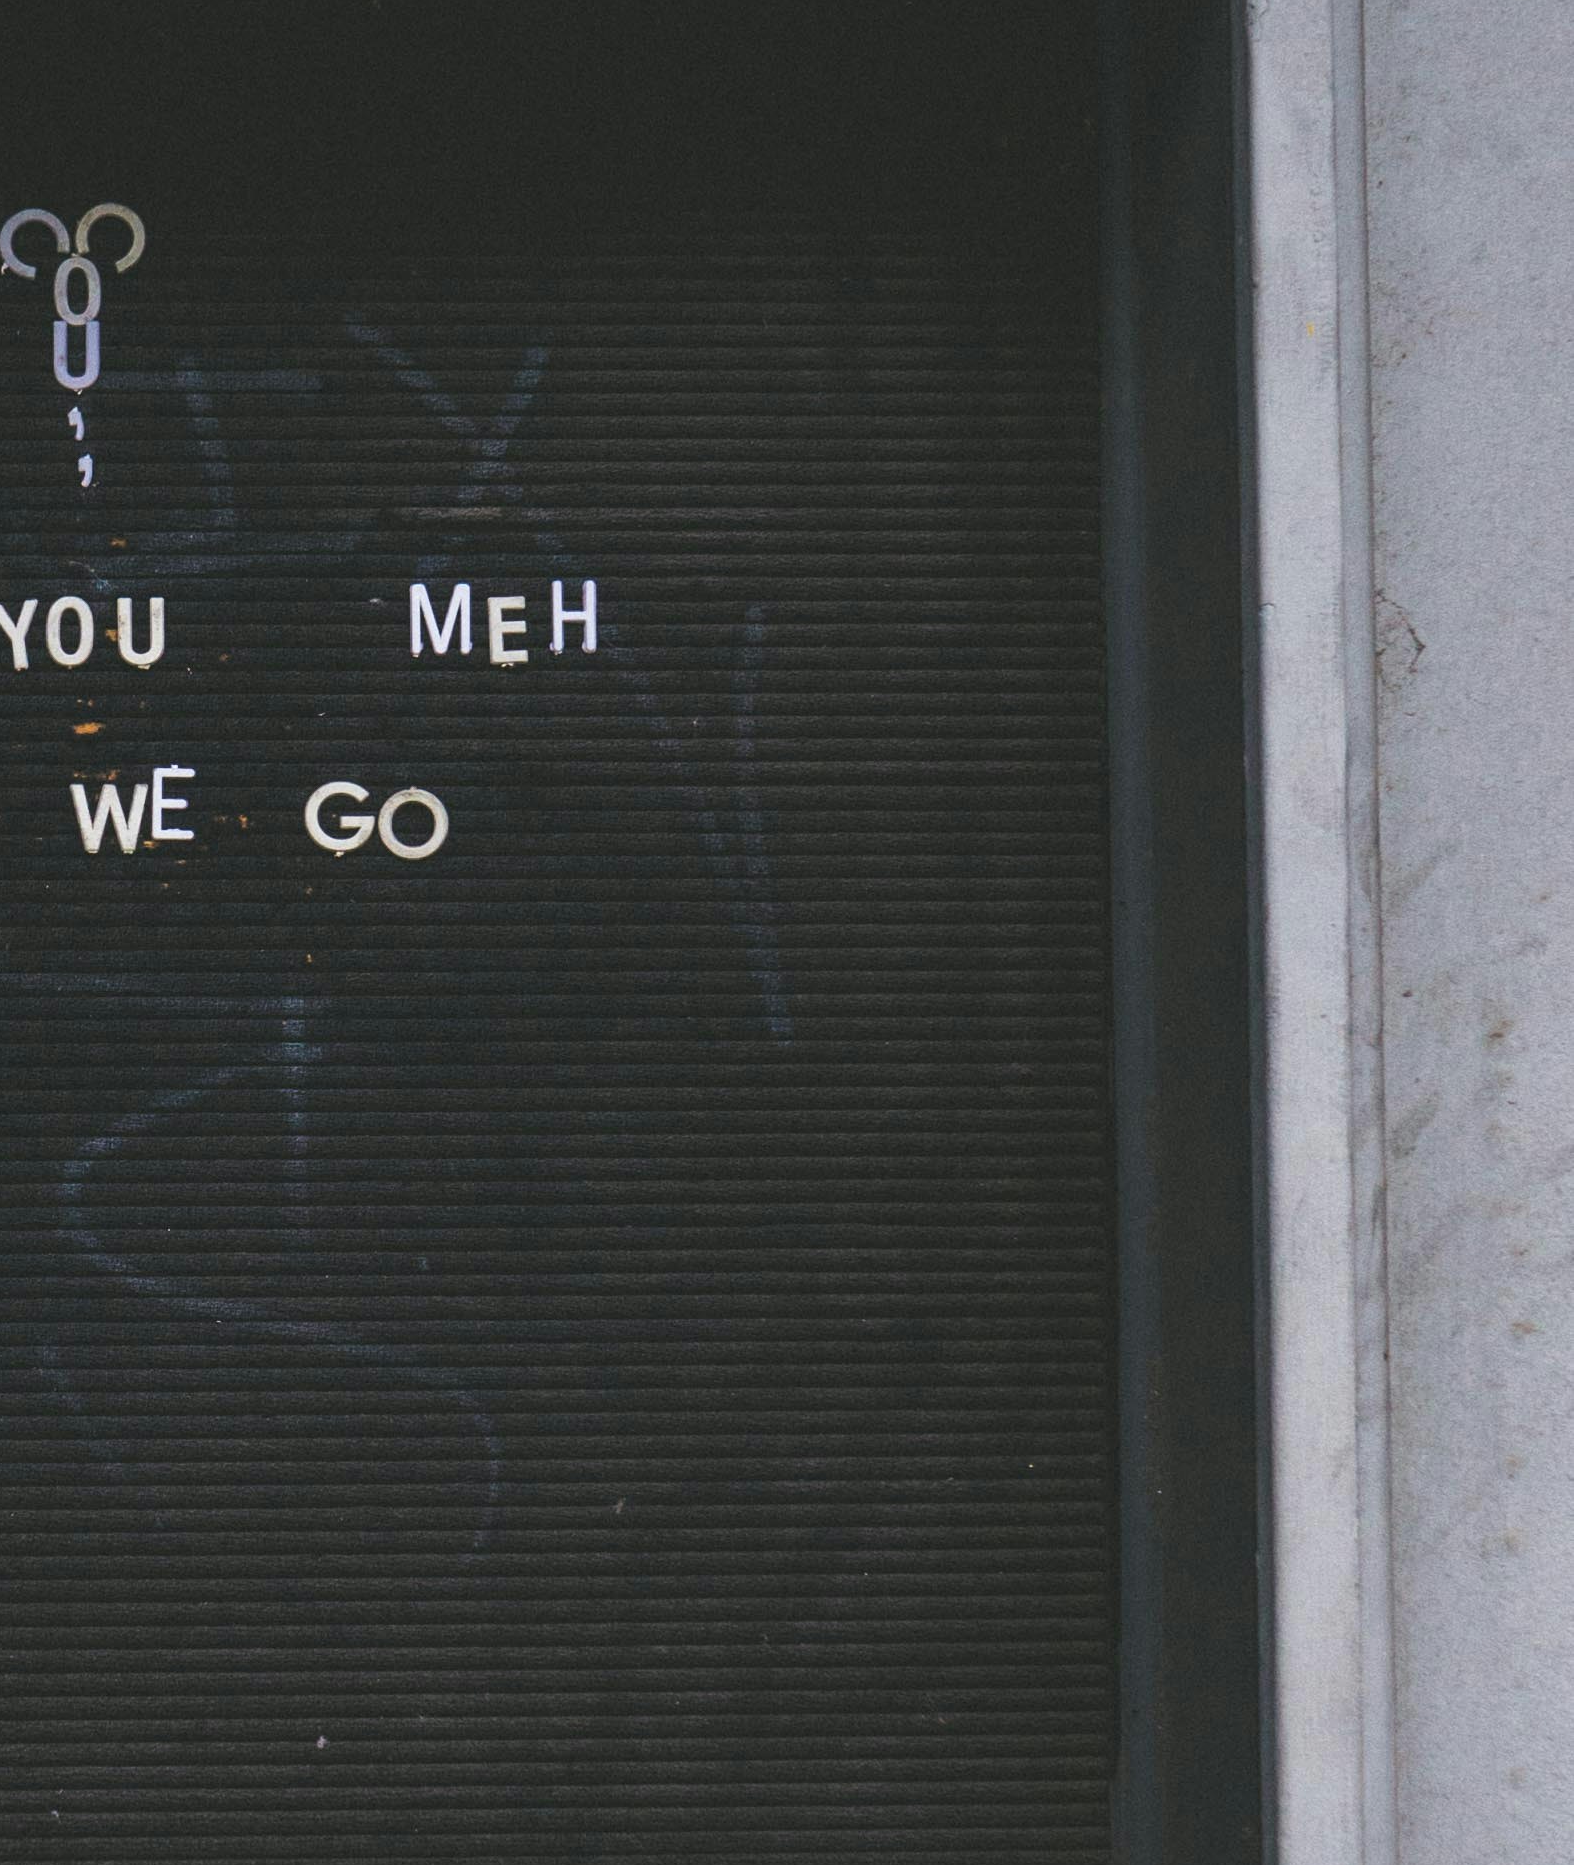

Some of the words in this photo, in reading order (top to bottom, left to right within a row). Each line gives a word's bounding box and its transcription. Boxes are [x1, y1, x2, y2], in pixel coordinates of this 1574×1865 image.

[409, 578, 599, 668] MEH
[69, 763, 197, 856] WE
[303, 781, 450, 860] GO
